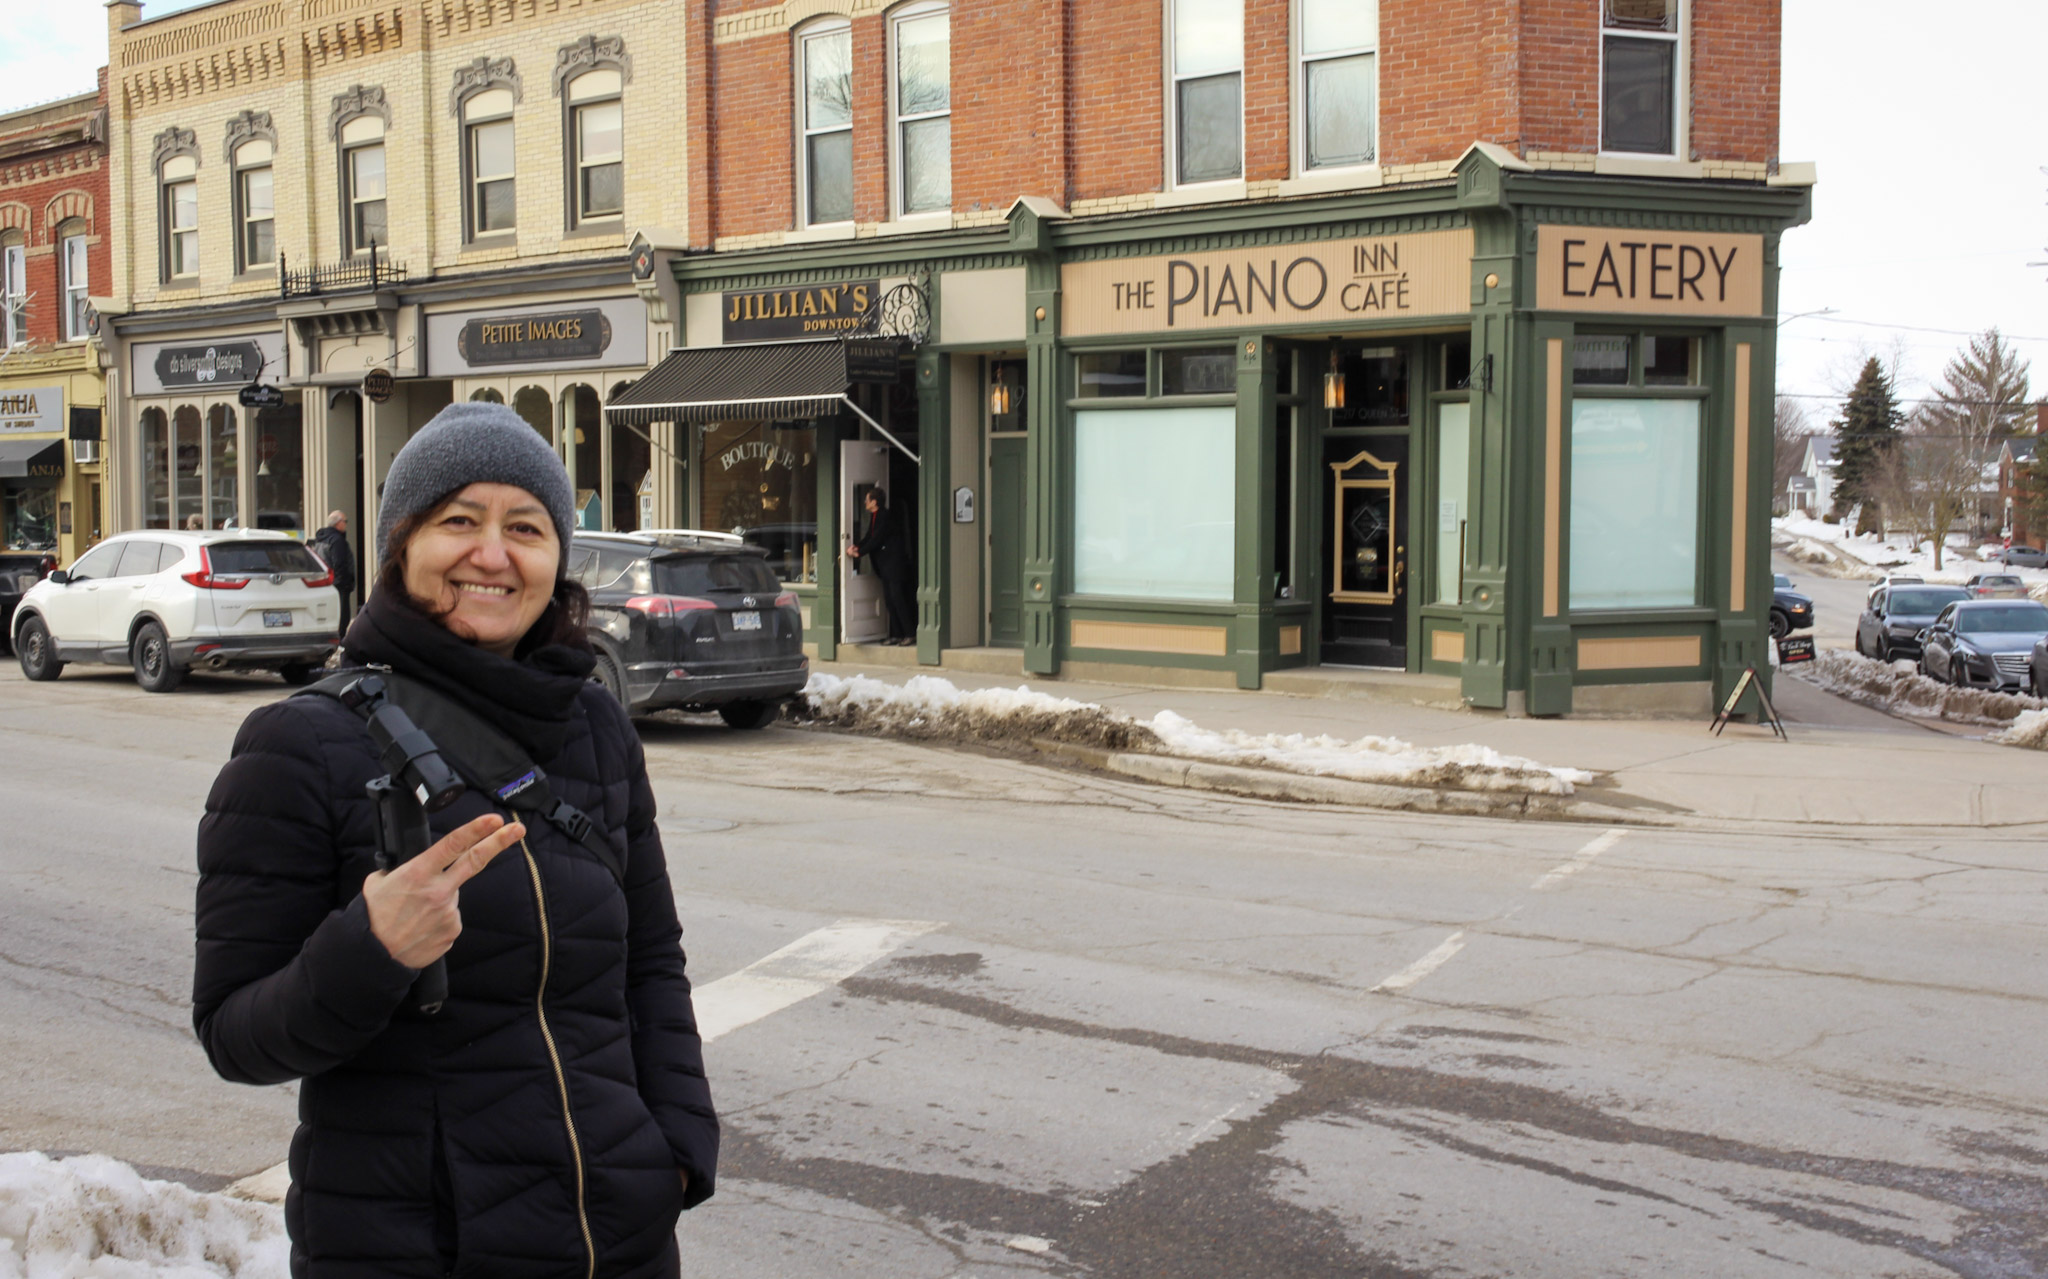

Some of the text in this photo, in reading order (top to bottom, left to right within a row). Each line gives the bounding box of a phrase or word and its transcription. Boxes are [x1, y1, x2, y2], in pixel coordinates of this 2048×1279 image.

[1352, 242, 1399, 274] INN
[1562, 239, 1738, 302] EATERY
[728, 282, 869, 322] JILLIAN'S
[1111, 256, 1410, 327] THE PIANO CAFÉ
[482, 318, 583, 345] PETITE IMAGES
[803, 316, 869, 332] DOWNTOW
[216, 349, 243, 375] designs
[1, 393, 39, 415] ANJA
[29, 464, 64, 476] ANJA
[720, 440, 795, 471] BOUTIQUE
